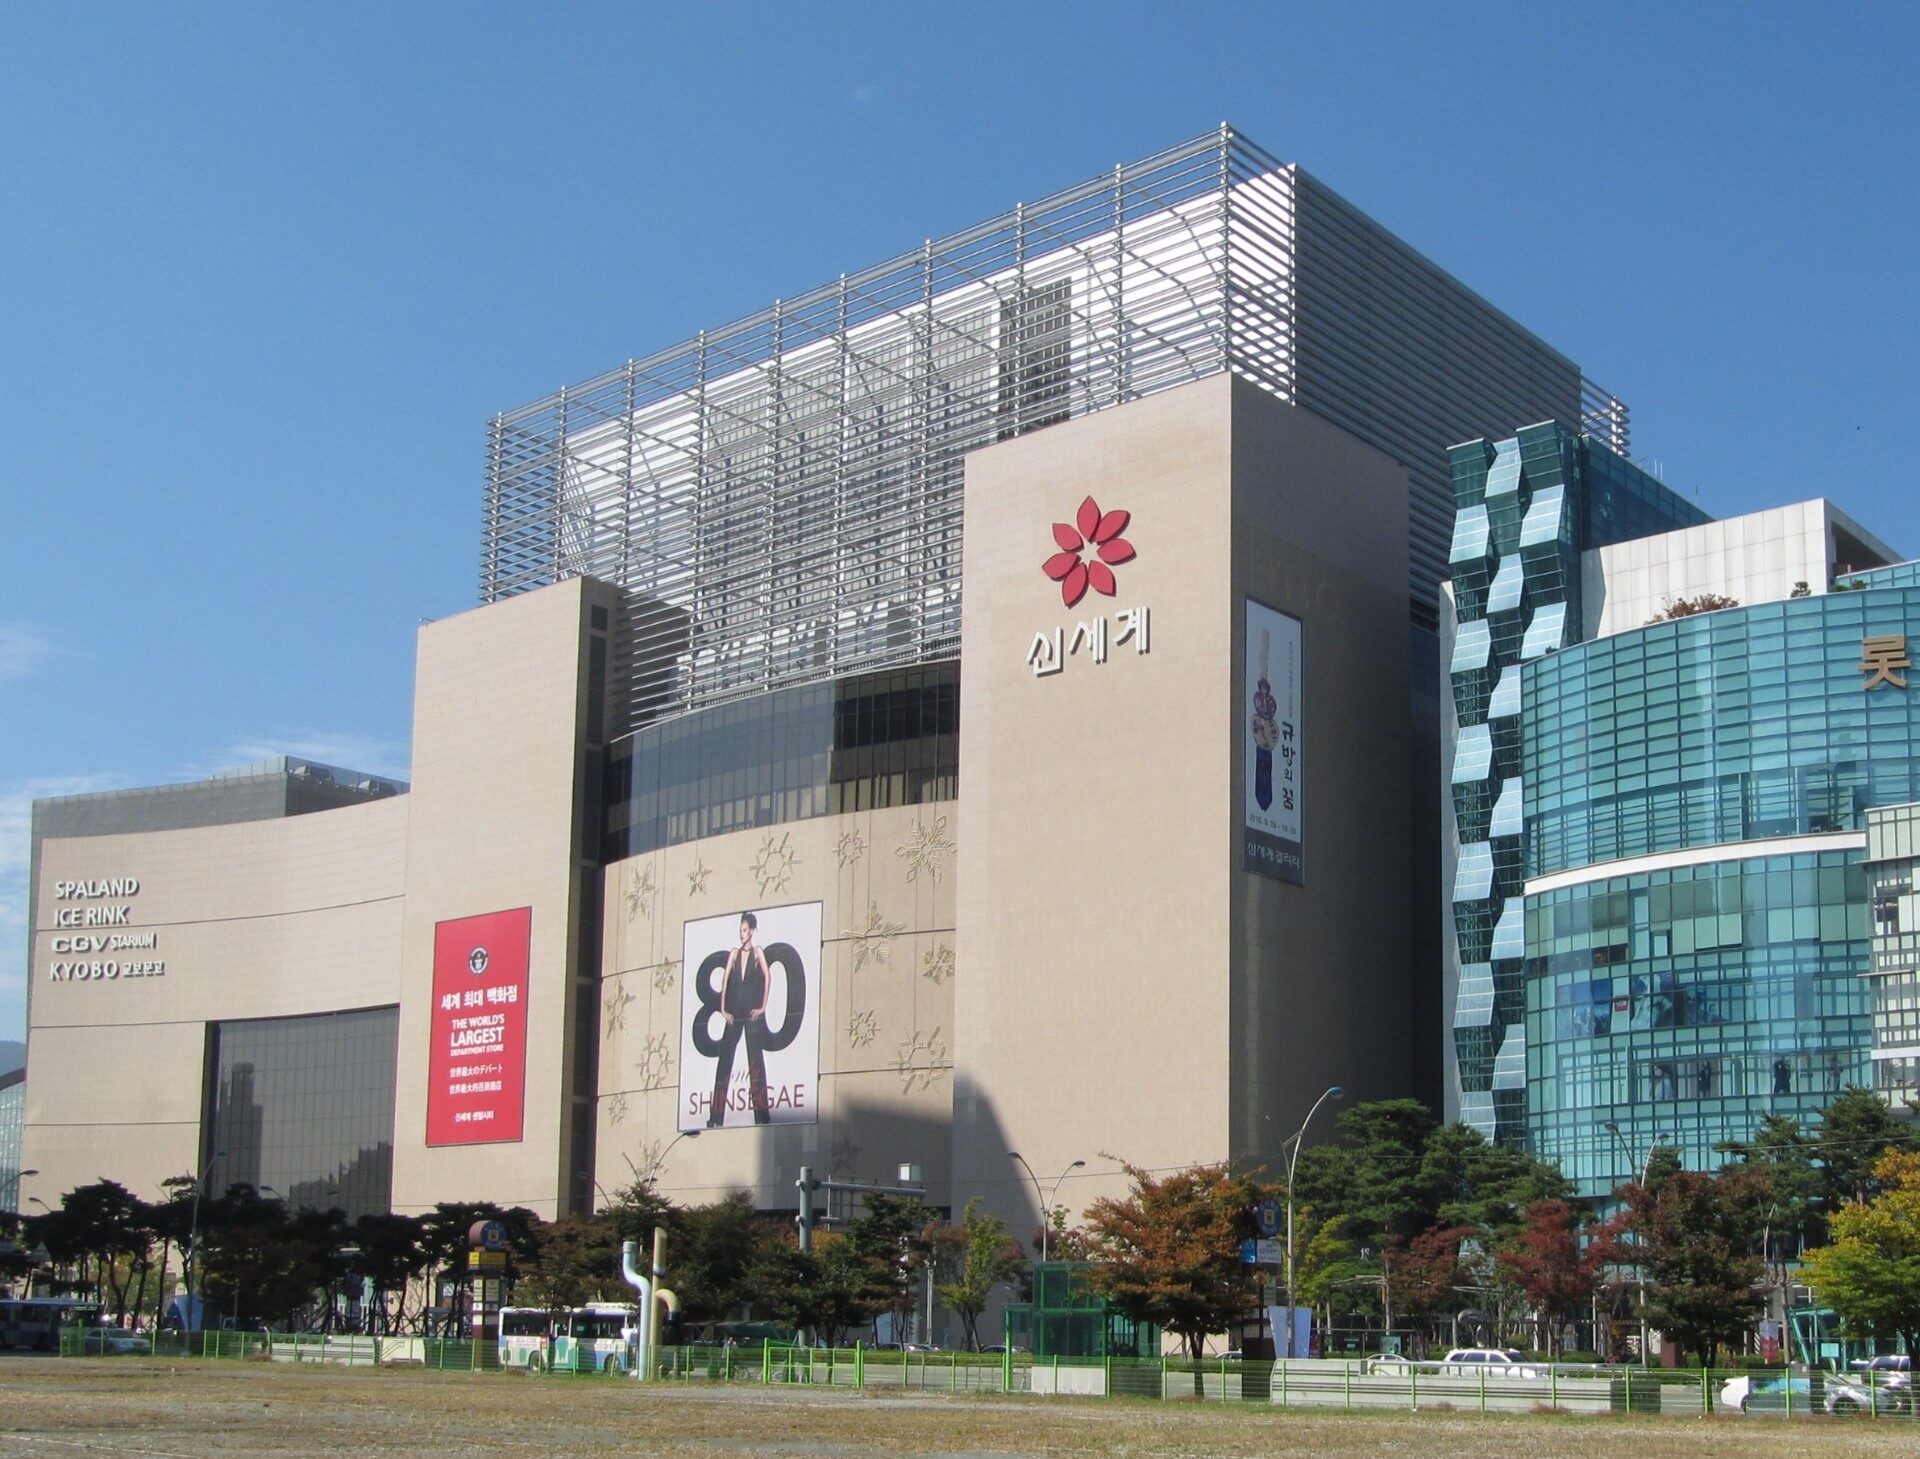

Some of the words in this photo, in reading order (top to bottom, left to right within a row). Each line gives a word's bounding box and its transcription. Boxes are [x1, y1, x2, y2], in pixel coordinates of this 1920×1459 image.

[1026, 605, 1150, 677] 신세계
[1856, 634, 1911, 690] 롯
[54, 877, 140, 900] SPALAND
[53, 907, 83, 927] ICE
[86, 905, 130, 926] RINK
[51, 935, 110, 954] CGV
[110, 932, 157, 949] STARIUM
[50, 960, 120, 981] KYOBO
[123, 960, 165, 978] 교보문고
[441, 992, 461, 1010] 세계
[463, 988, 484, 1008] 최대
[487, 984, 518, 1004] 백화점
[692, 942, 807, 1058] 80
[451, 1017, 468, 1029] THE
[468, 1013, 505, 1027] WORLD'S
[451, 1026, 505, 1047] LARGEST
[450, 1045, 486, 1057] DEPARTMENT
[486, 1043, 505, 1054] STORE
